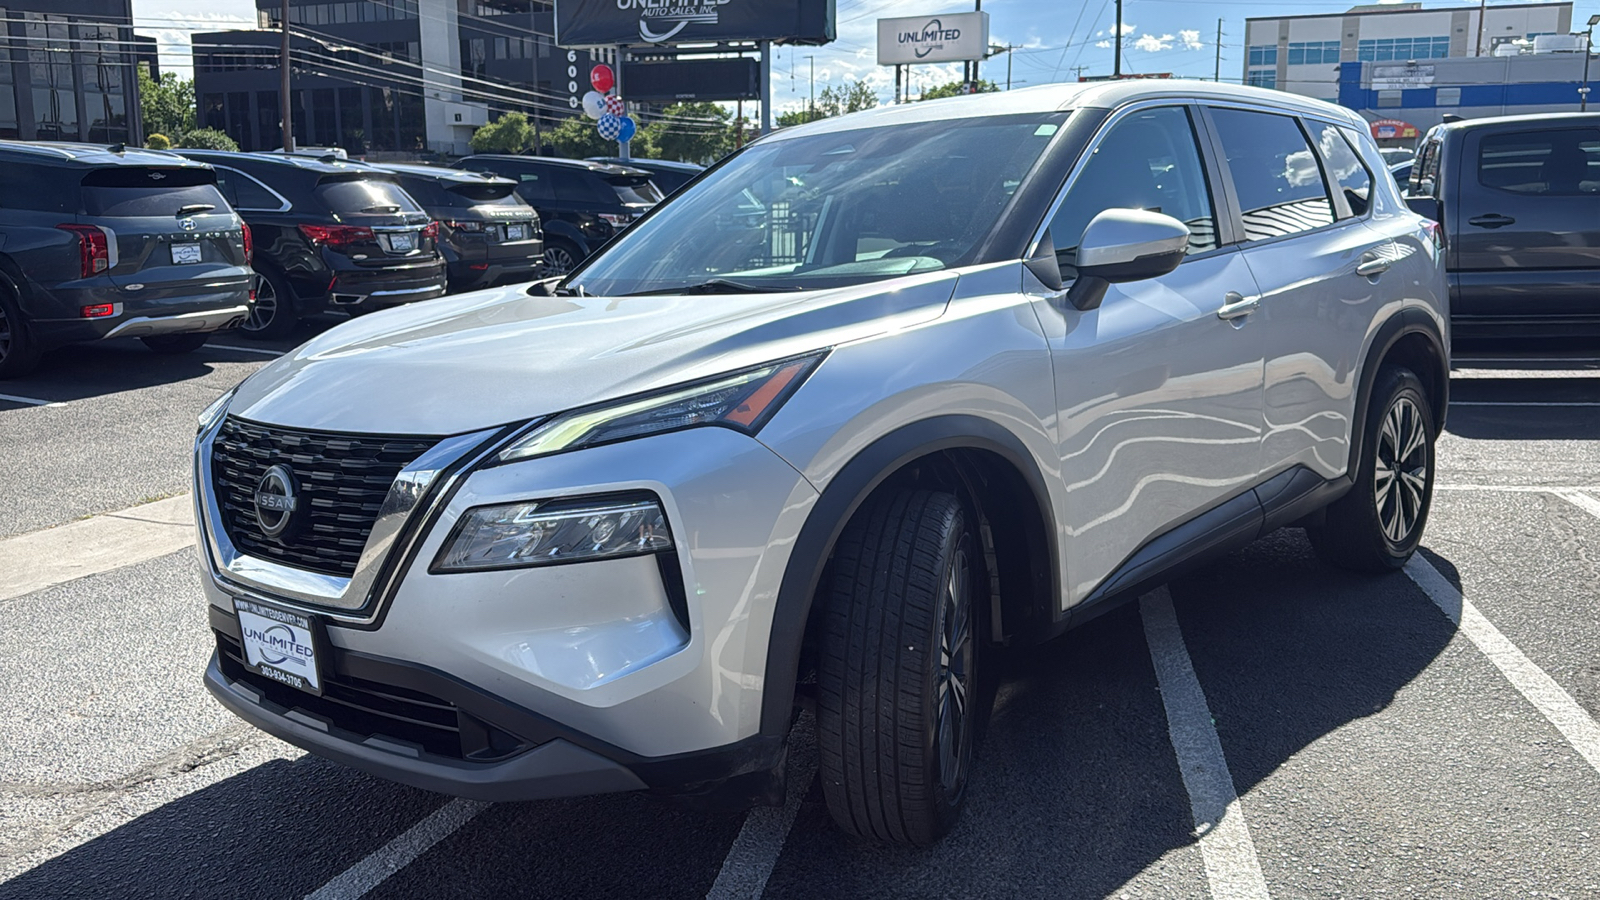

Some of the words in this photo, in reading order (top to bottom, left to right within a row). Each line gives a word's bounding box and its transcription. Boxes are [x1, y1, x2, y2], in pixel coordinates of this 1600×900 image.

[641, 7, 668, 17] AUTO
[669, 5, 696, 15] SALES,
[699, 5, 718, 14] INC.
[898, 29, 961, 43] UNLIMITED
[567, 50, 579, 108] 6000
[1371, 119, 1404, 127] ENTRANCE
[255, 493, 295, 509] NISSAN
[244, 627, 314, 657] UNLIMITED
[260, 665, 303, 688] 303-934-3705
